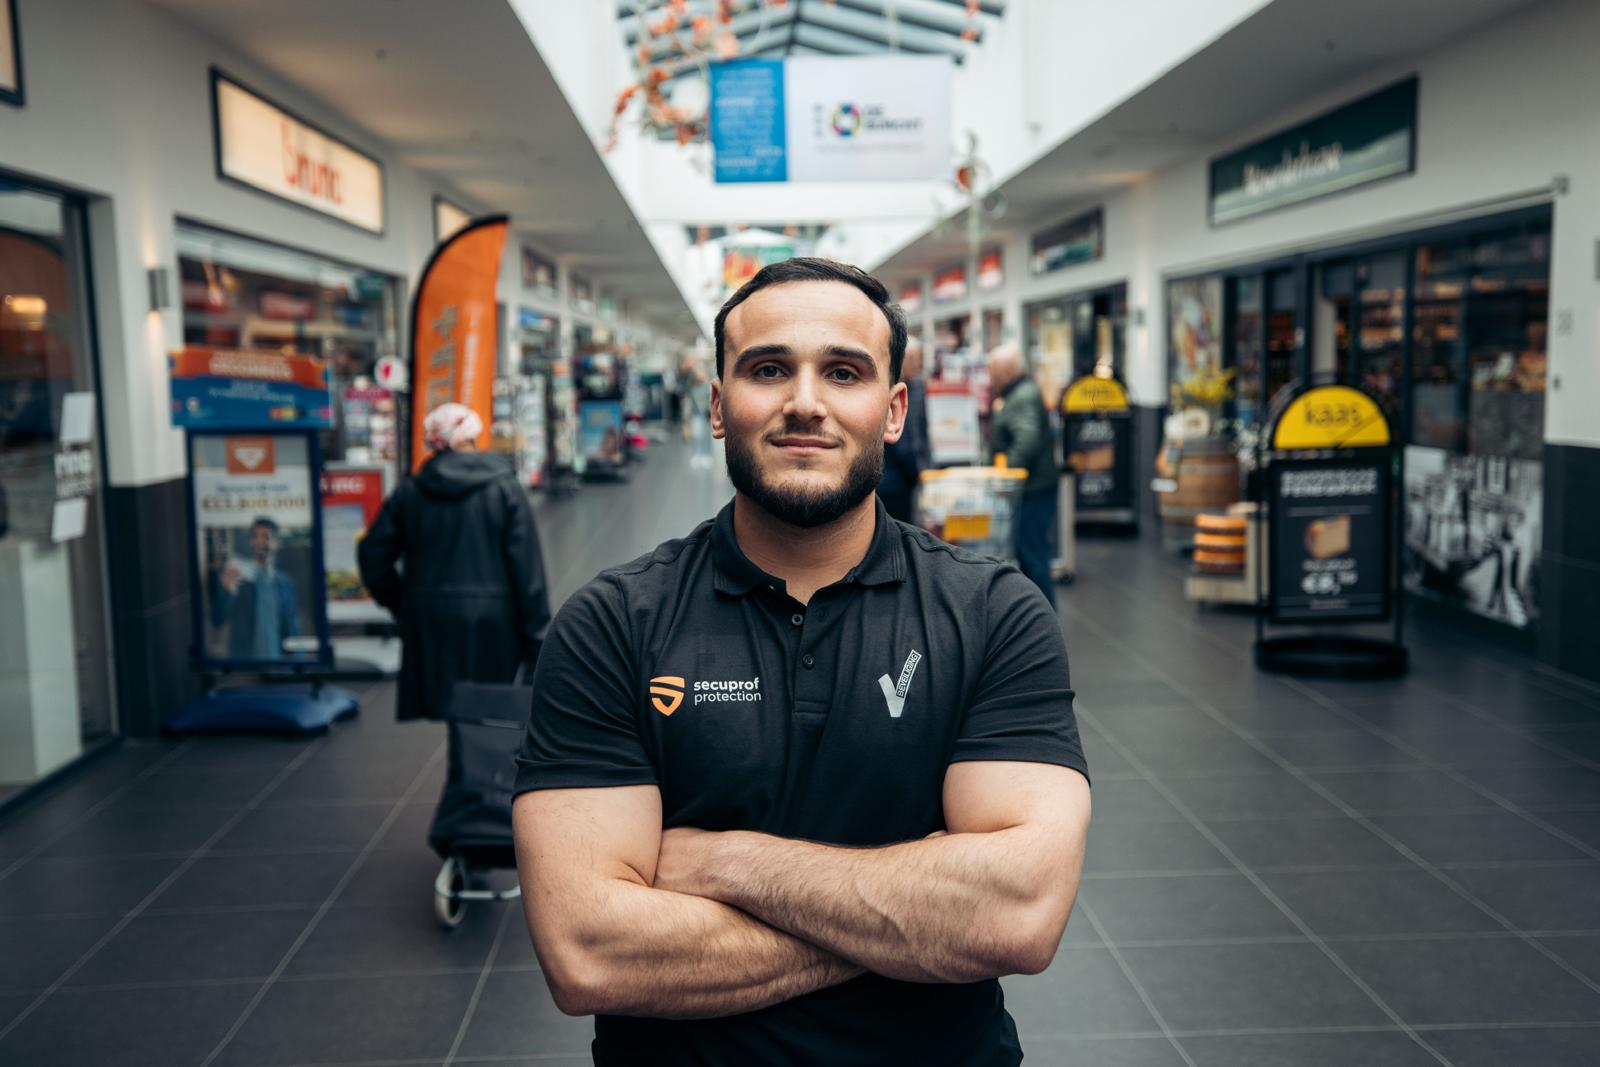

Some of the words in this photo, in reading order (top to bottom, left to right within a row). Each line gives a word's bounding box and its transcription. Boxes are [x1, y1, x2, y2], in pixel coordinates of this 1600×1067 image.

[1303, 400, 1363, 428] kaas
[693, 677, 760, 693] secuprof
[896, 652, 919, 697] BEVEILIGING
[694, 690, 762, 706] protection
